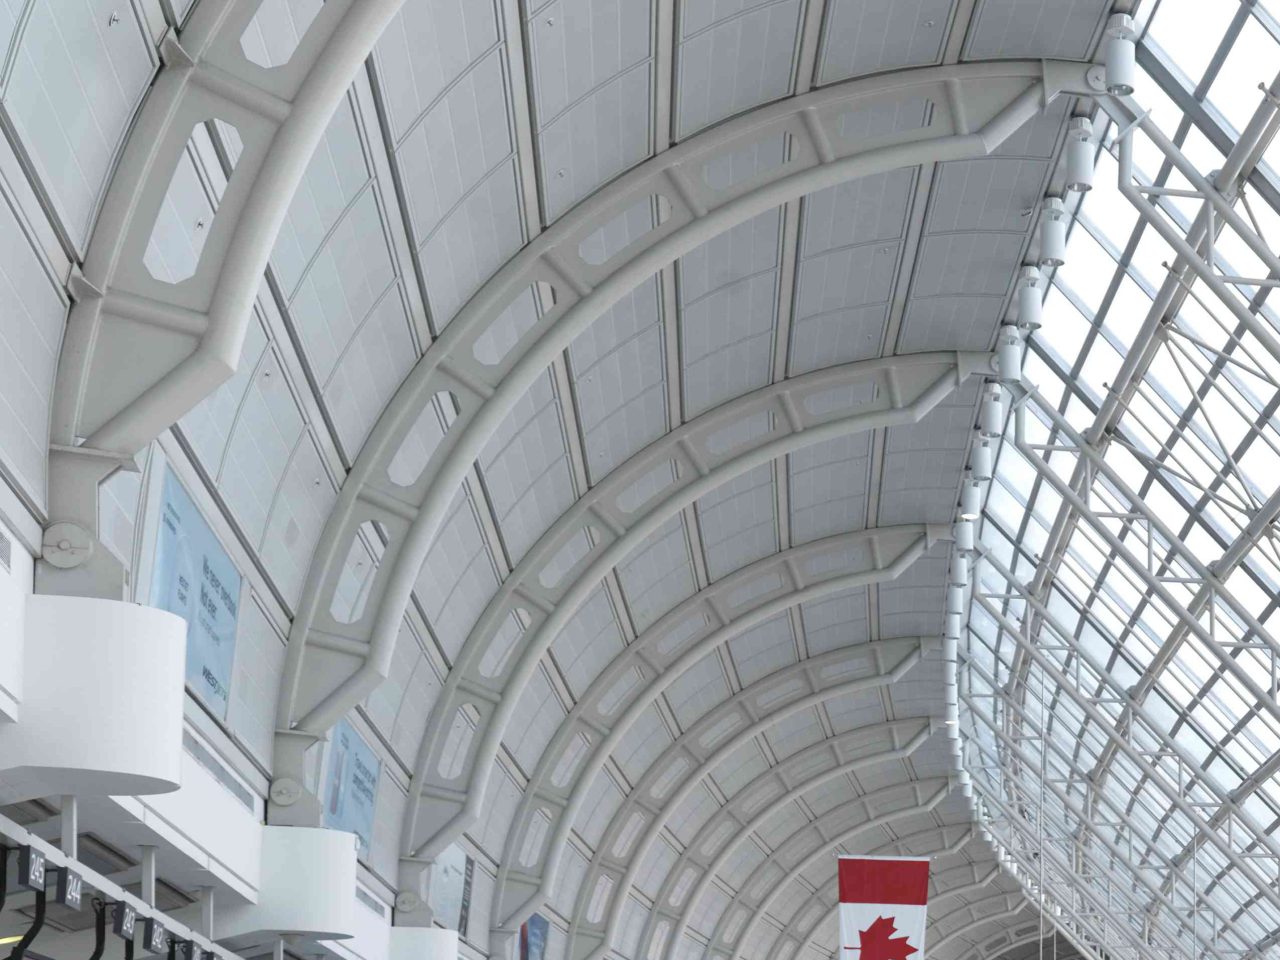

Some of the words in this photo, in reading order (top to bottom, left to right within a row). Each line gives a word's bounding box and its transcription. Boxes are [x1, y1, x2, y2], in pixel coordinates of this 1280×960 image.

[30, 854, 45, 883] 245
[66, 875, 81, 905] 244
[123, 908, 135, 935] 243
[152, 924, 163, 949] 242
